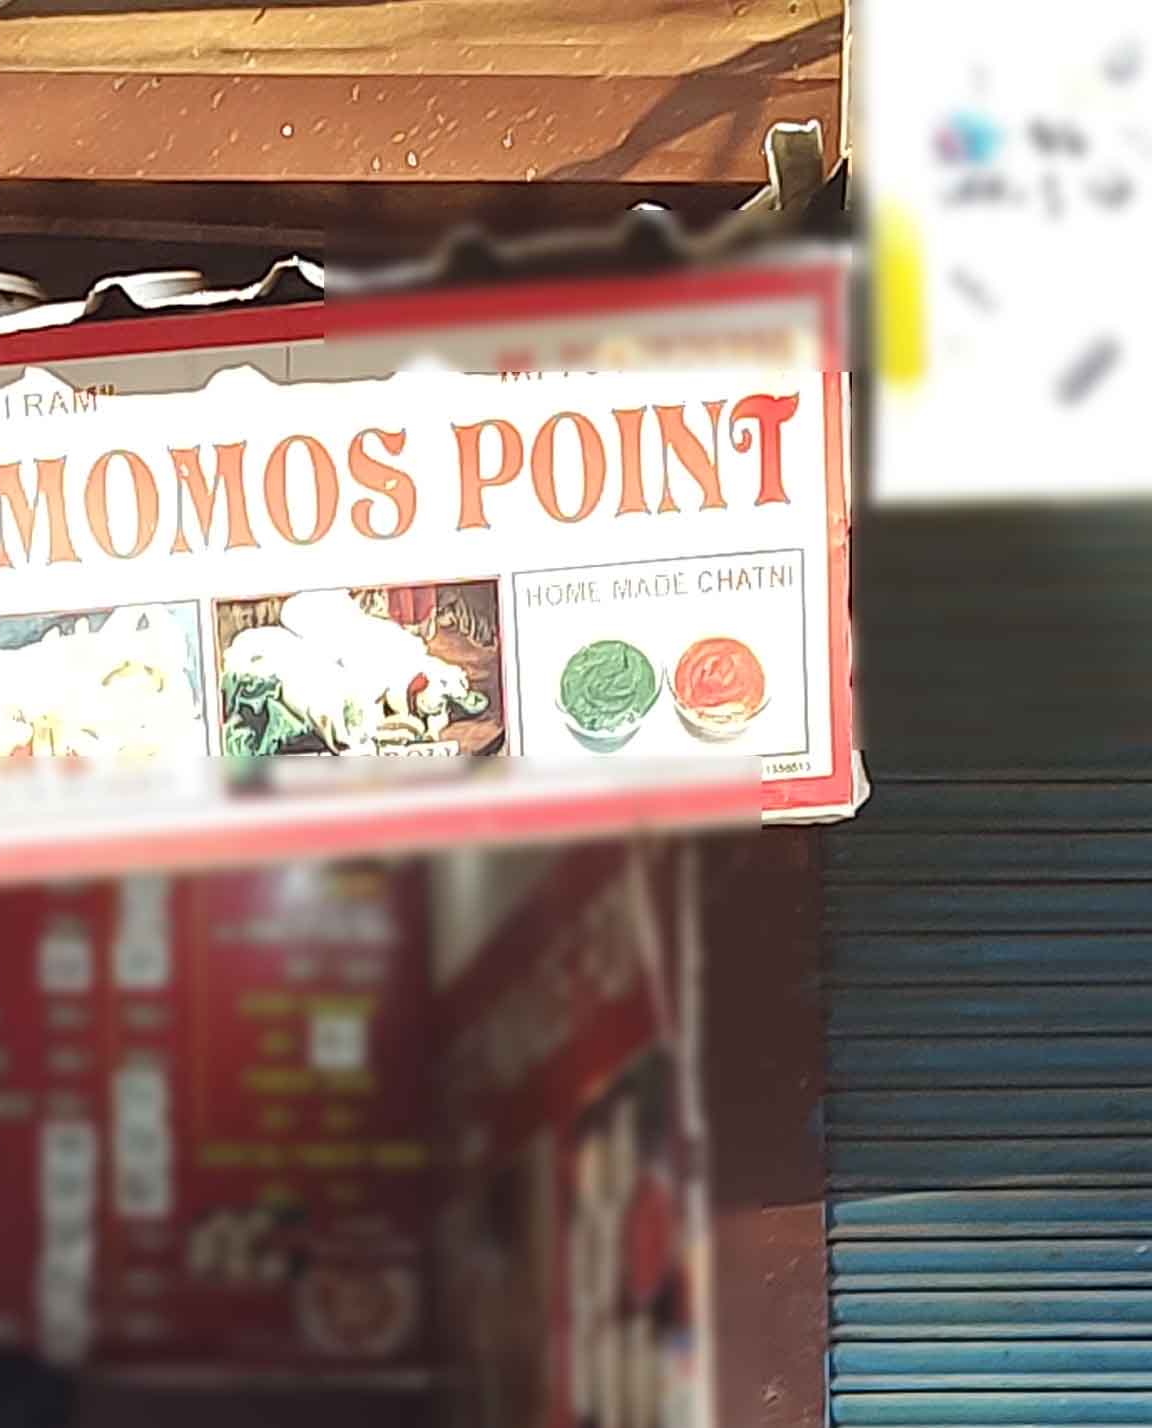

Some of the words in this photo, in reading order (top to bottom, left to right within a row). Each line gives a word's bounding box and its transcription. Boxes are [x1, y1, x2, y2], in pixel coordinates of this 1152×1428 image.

[451, 391, 800, 532] POINT
[526, 580, 601, 608] HOME
[612, 571, 689, 601] MADE
[697, 565, 793, 594] CHATNI
